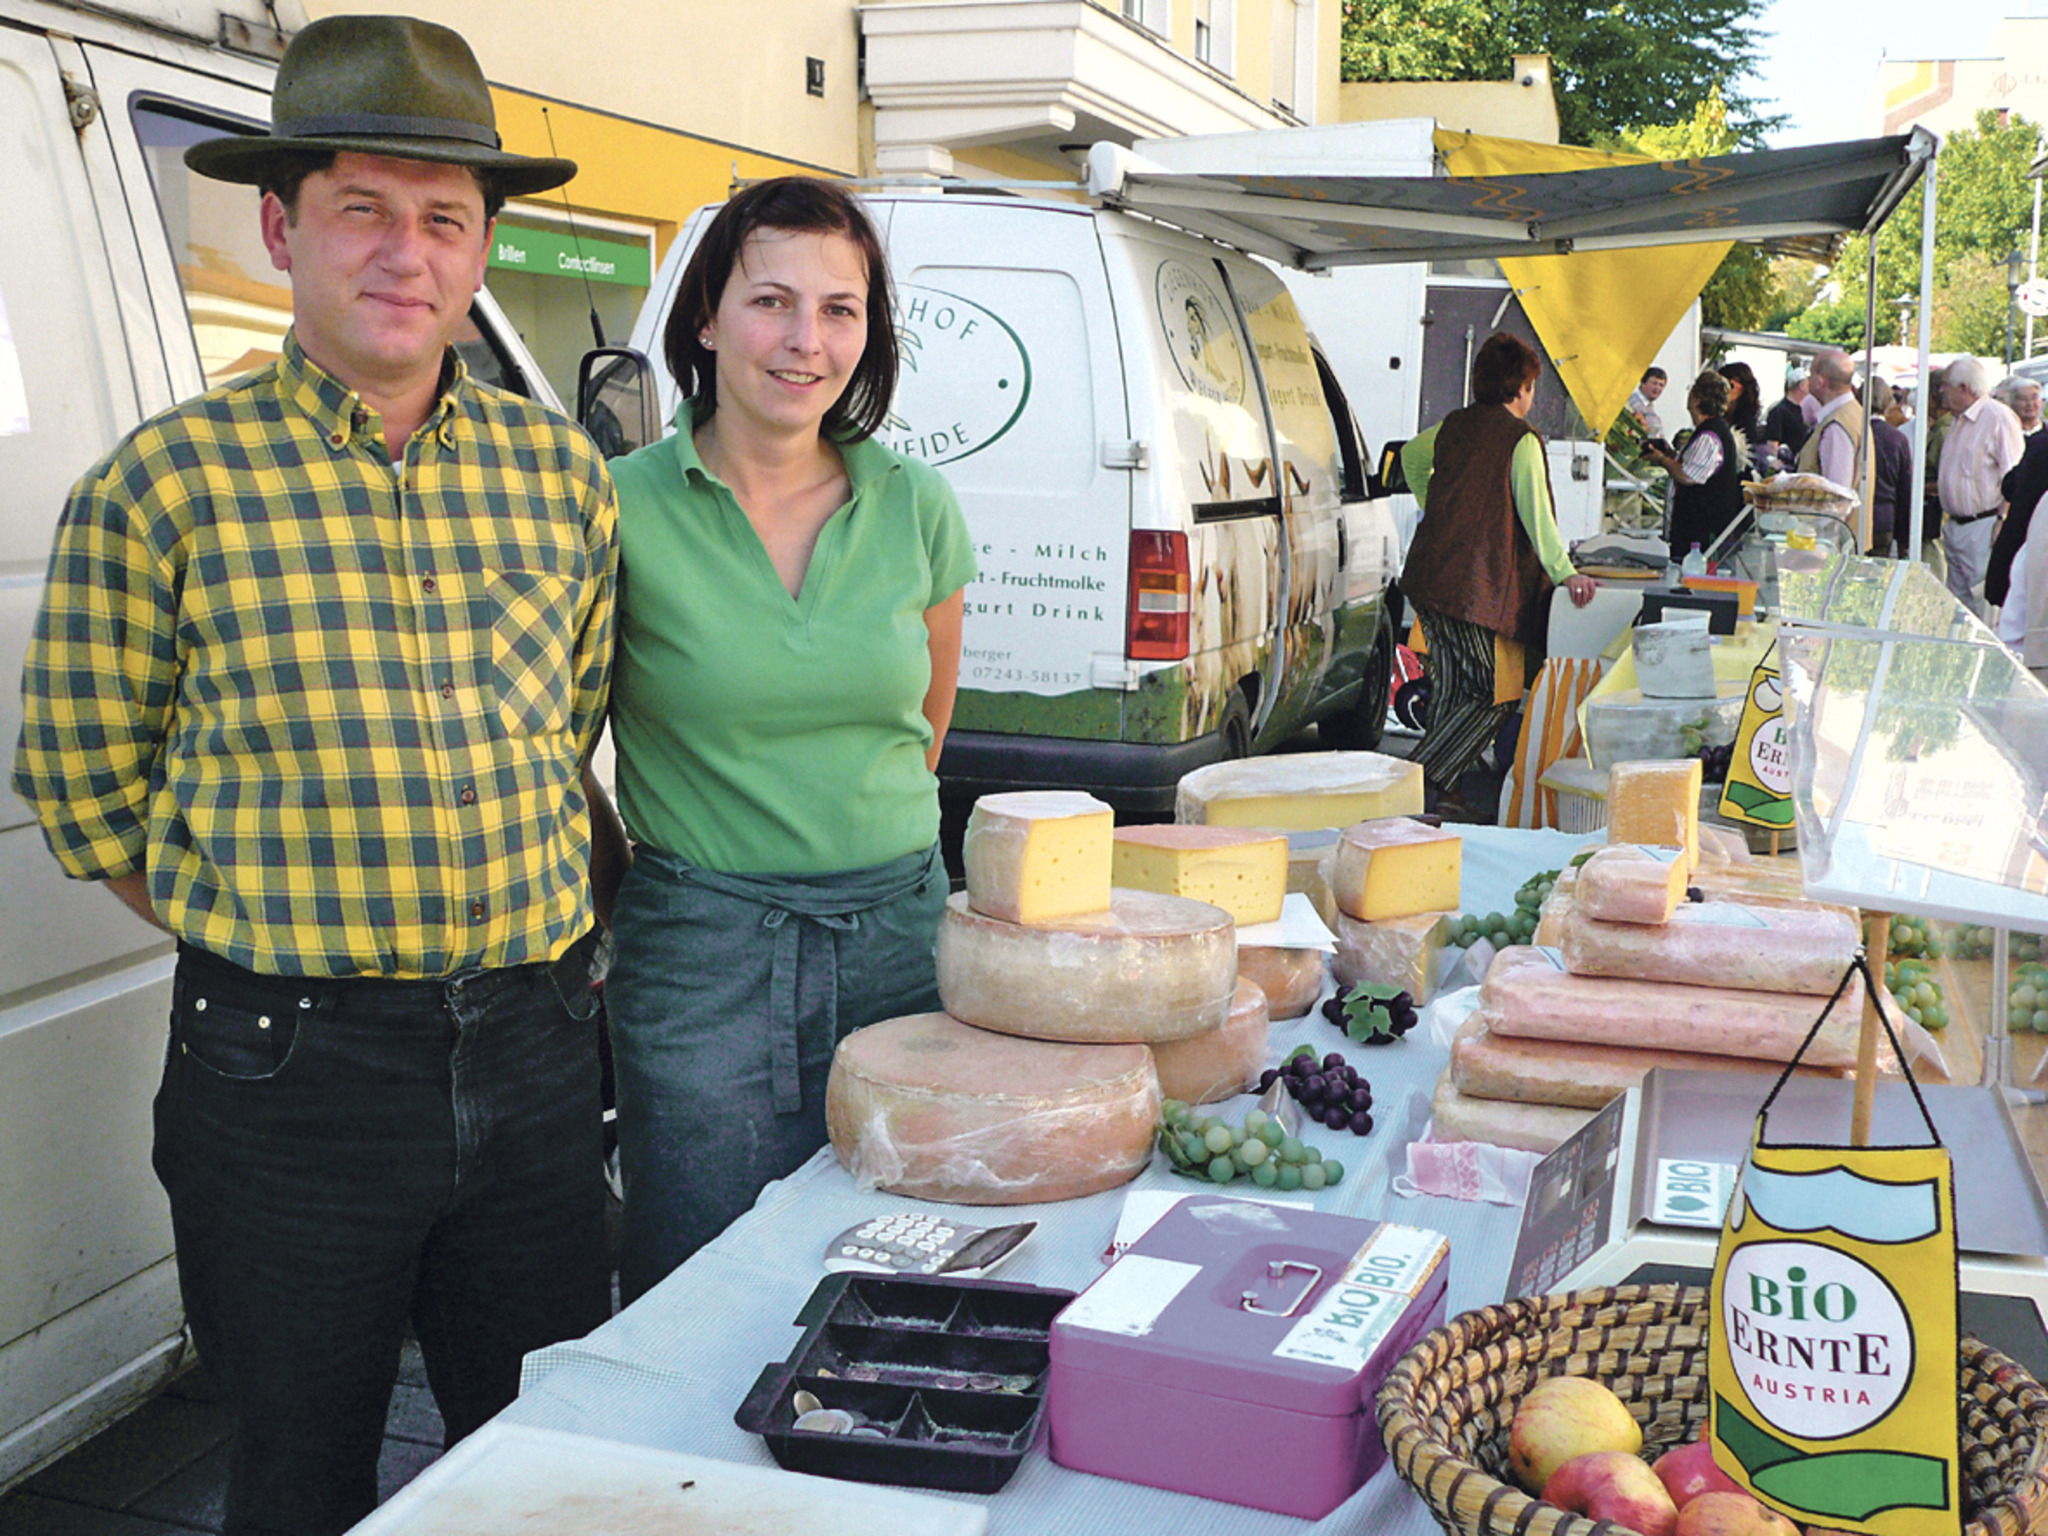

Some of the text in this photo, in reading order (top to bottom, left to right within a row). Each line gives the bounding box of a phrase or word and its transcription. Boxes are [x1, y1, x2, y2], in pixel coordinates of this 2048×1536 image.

[498, 243, 526, 263] Brillen
[1035, 544, 1107, 561] Milch
[1001, 571, 1106, 592] Fruchtmolke
[1032, 603, 1104, 621] Drink
[972, 666, 1081, 685] 07243-58137
[1666, 1162, 1711, 1193] BIO
[1730, 1303, 1891, 1377] ERNTE
[1753, 1373, 1871, 1405] AUSTRIA
